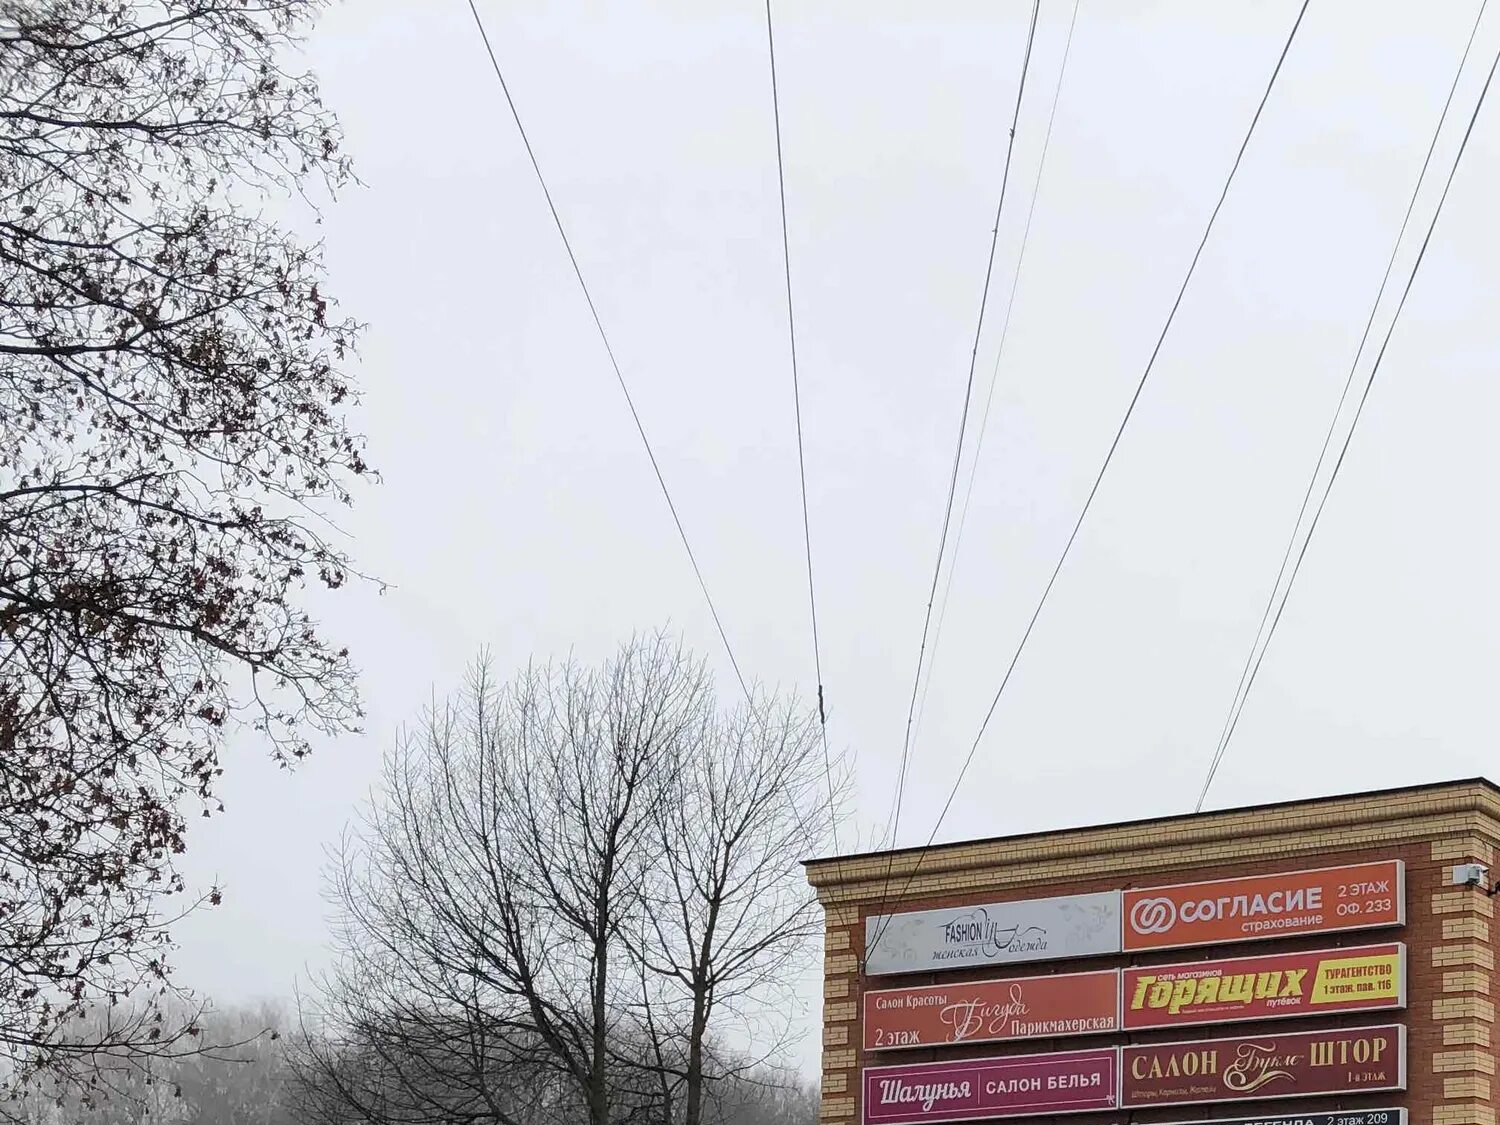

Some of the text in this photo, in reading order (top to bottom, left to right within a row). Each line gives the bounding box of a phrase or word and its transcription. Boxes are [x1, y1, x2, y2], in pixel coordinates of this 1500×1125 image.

[1338, 880, 1390, 898] 2 ЭТАЖ
[1179, 886, 1323, 923] СОГЛАСИЕ
[1336, 899, 1392, 916] ОФ. 233
[945, 920, 982, 944] FASHION
[1241, 914, 1323, 934] страхование
[932, 938, 1048, 960] женская одежда
[1177, 969, 1222, 981] магазинов
[1325, 964, 1392, 980] ТУРАГЕНТСТВО
[1377, 981, 1392, 991] 116
[876, 994, 947, 1010] Салон Красоты
[1011, 1016, 1114, 1036] Парикмахерская
[875, 1029, 920, 1046] 2 этаж
[1131, 1037, 1387, 1080] САЛОН ШТОР
[985, 1072, 1101, 1095] САЛОН БЕЛЬЯ
[879, 1079, 971, 1112] Шалунья
[1366, 1113, 1388, 1125] 209
